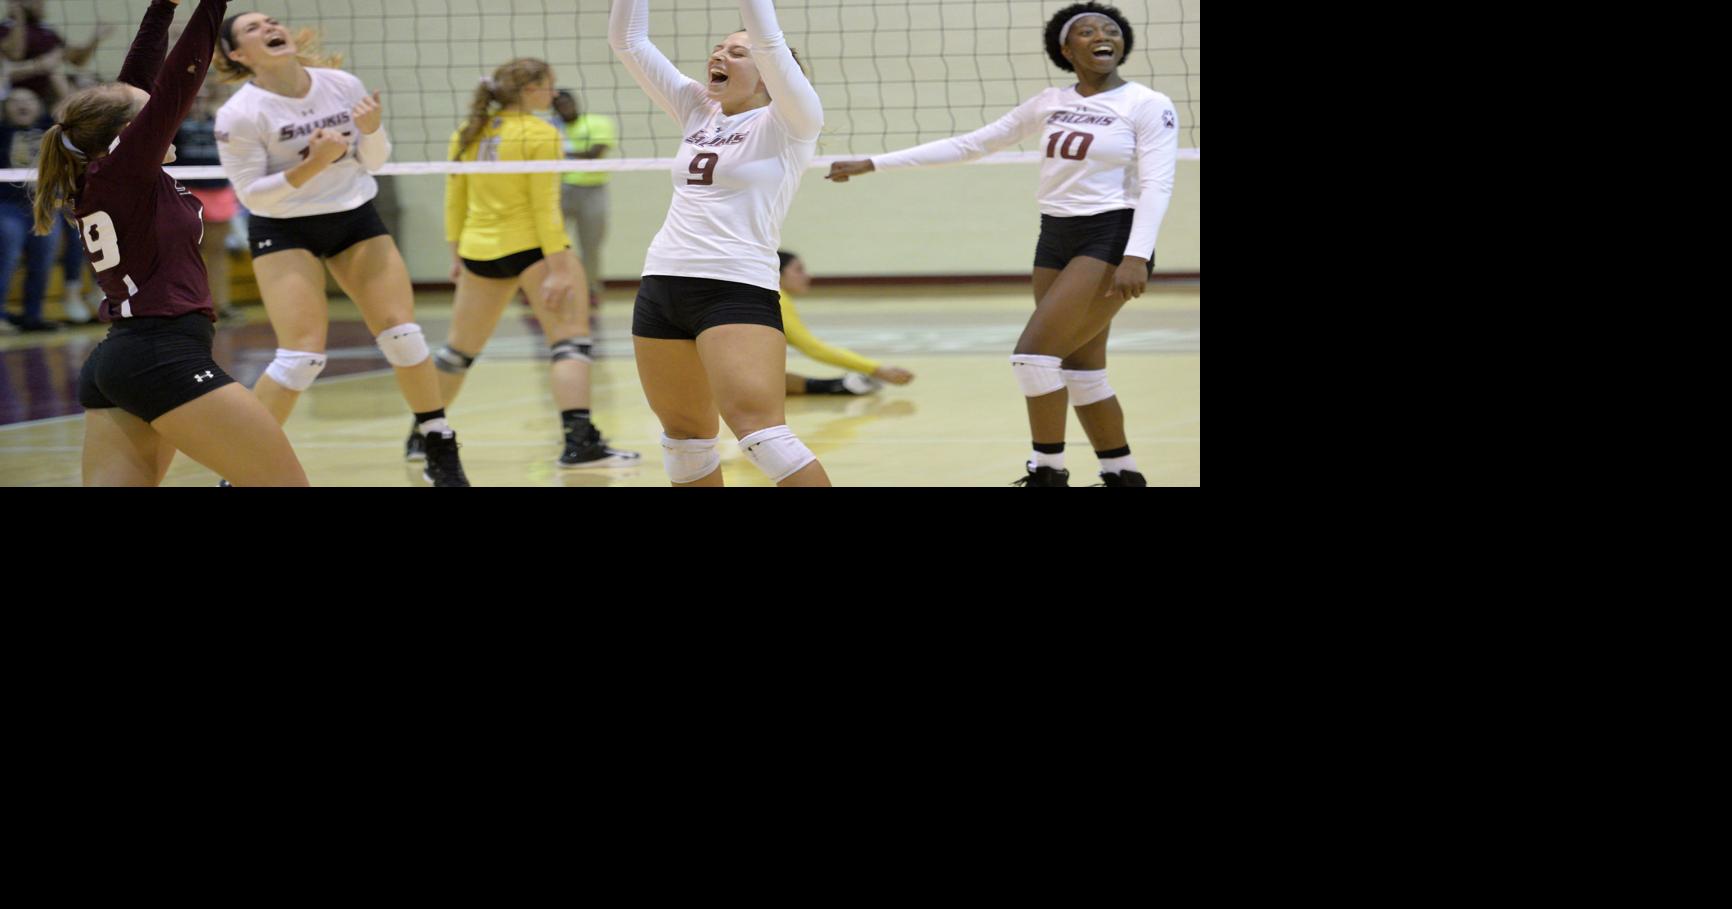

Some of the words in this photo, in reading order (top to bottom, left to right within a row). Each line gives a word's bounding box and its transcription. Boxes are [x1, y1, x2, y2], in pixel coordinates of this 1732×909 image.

[279, 111, 350, 142] SALUKIS
[1046, 131, 1094, 161] 10
[687, 152, 719, 186] 9
[75, 210, 121, 273] 9
